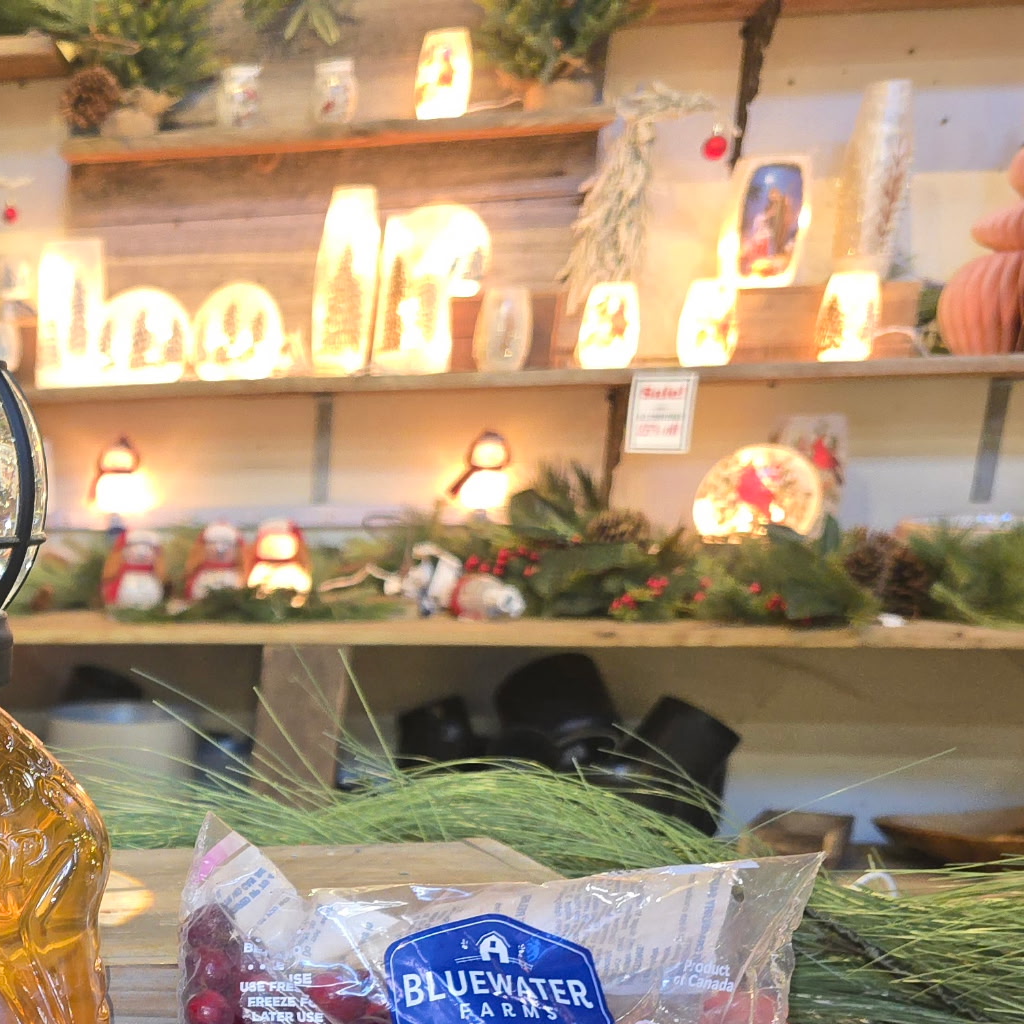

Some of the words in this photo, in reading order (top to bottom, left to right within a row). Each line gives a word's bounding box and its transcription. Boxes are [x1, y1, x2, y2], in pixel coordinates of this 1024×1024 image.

[683, 960, 730, 976] Product
[240, 982, 266, 992] USE
[403, 970, 594, 1009] BLUEWATER
[673, 973, 686, 986] of
[688, 974, 734, 992] Canada
[247, 997, 296, 1008] FREEZE
[296, 1011, 325, 1022] USE
[460, 1002, 558, 1020] FARMS
